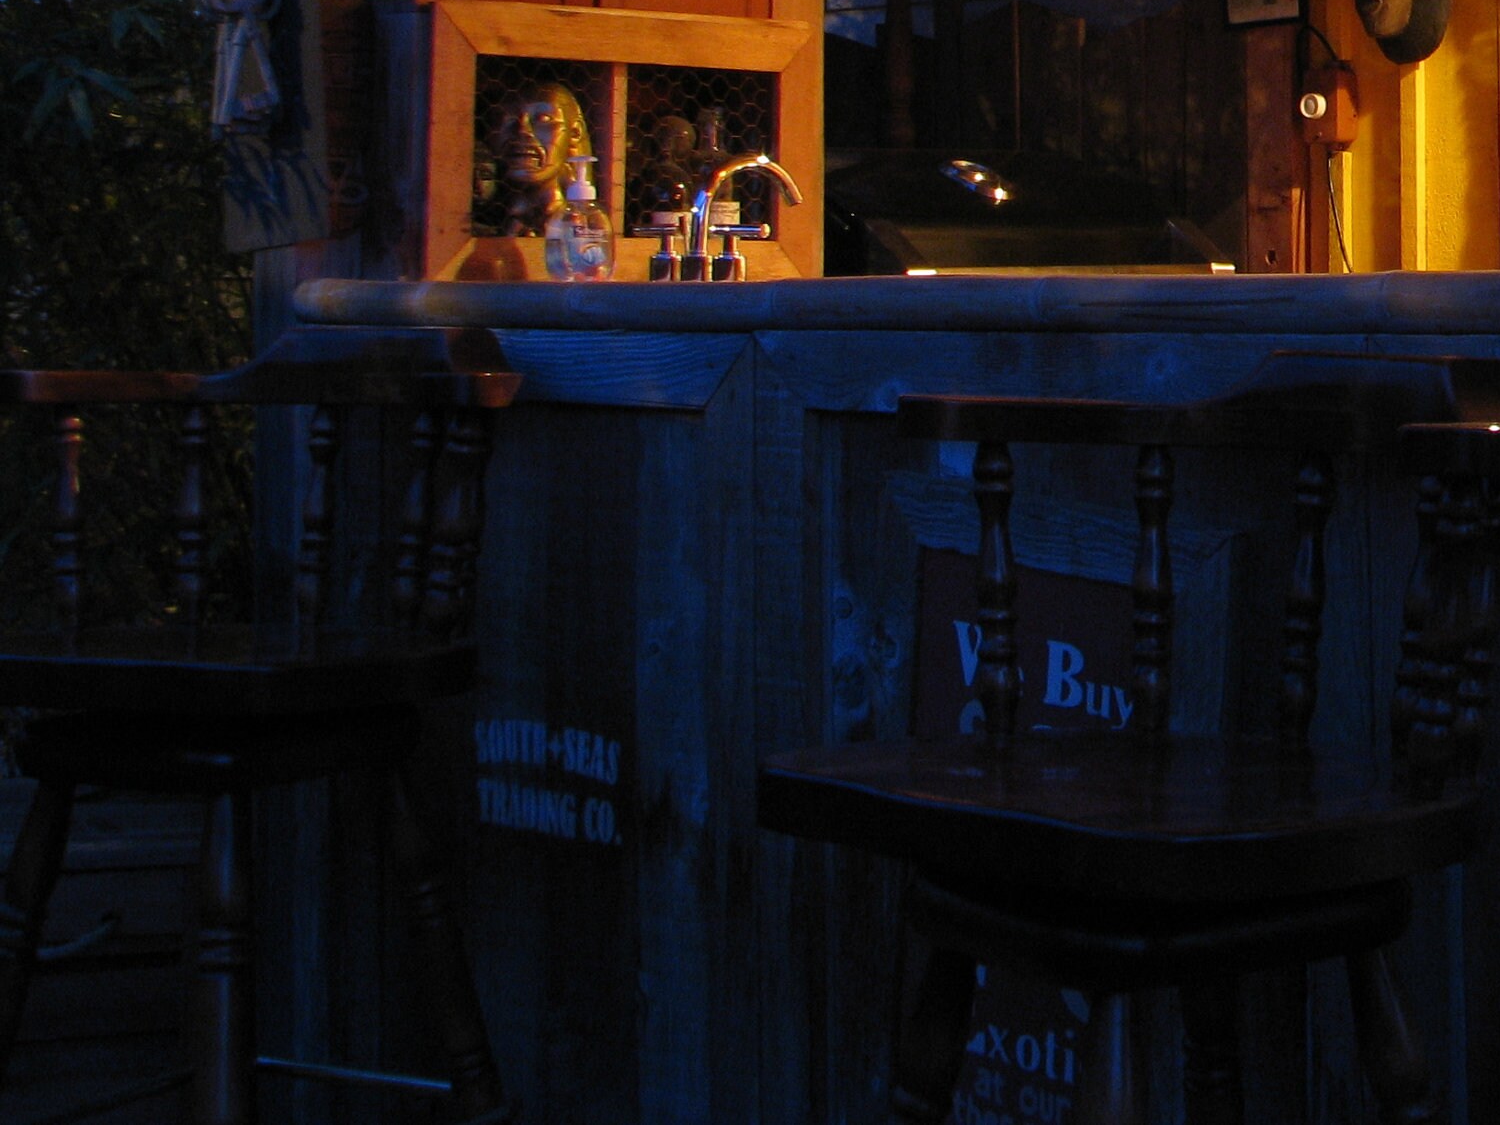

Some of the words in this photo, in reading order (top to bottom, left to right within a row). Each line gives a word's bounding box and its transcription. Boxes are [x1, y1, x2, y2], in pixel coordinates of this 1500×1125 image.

[1041, 638, 1136, 731] Buy
[476, 778, 578, 841] TRADING
[583, 797, 624, 845] CO.
[964, 1022, 1077, 1084] xoti
